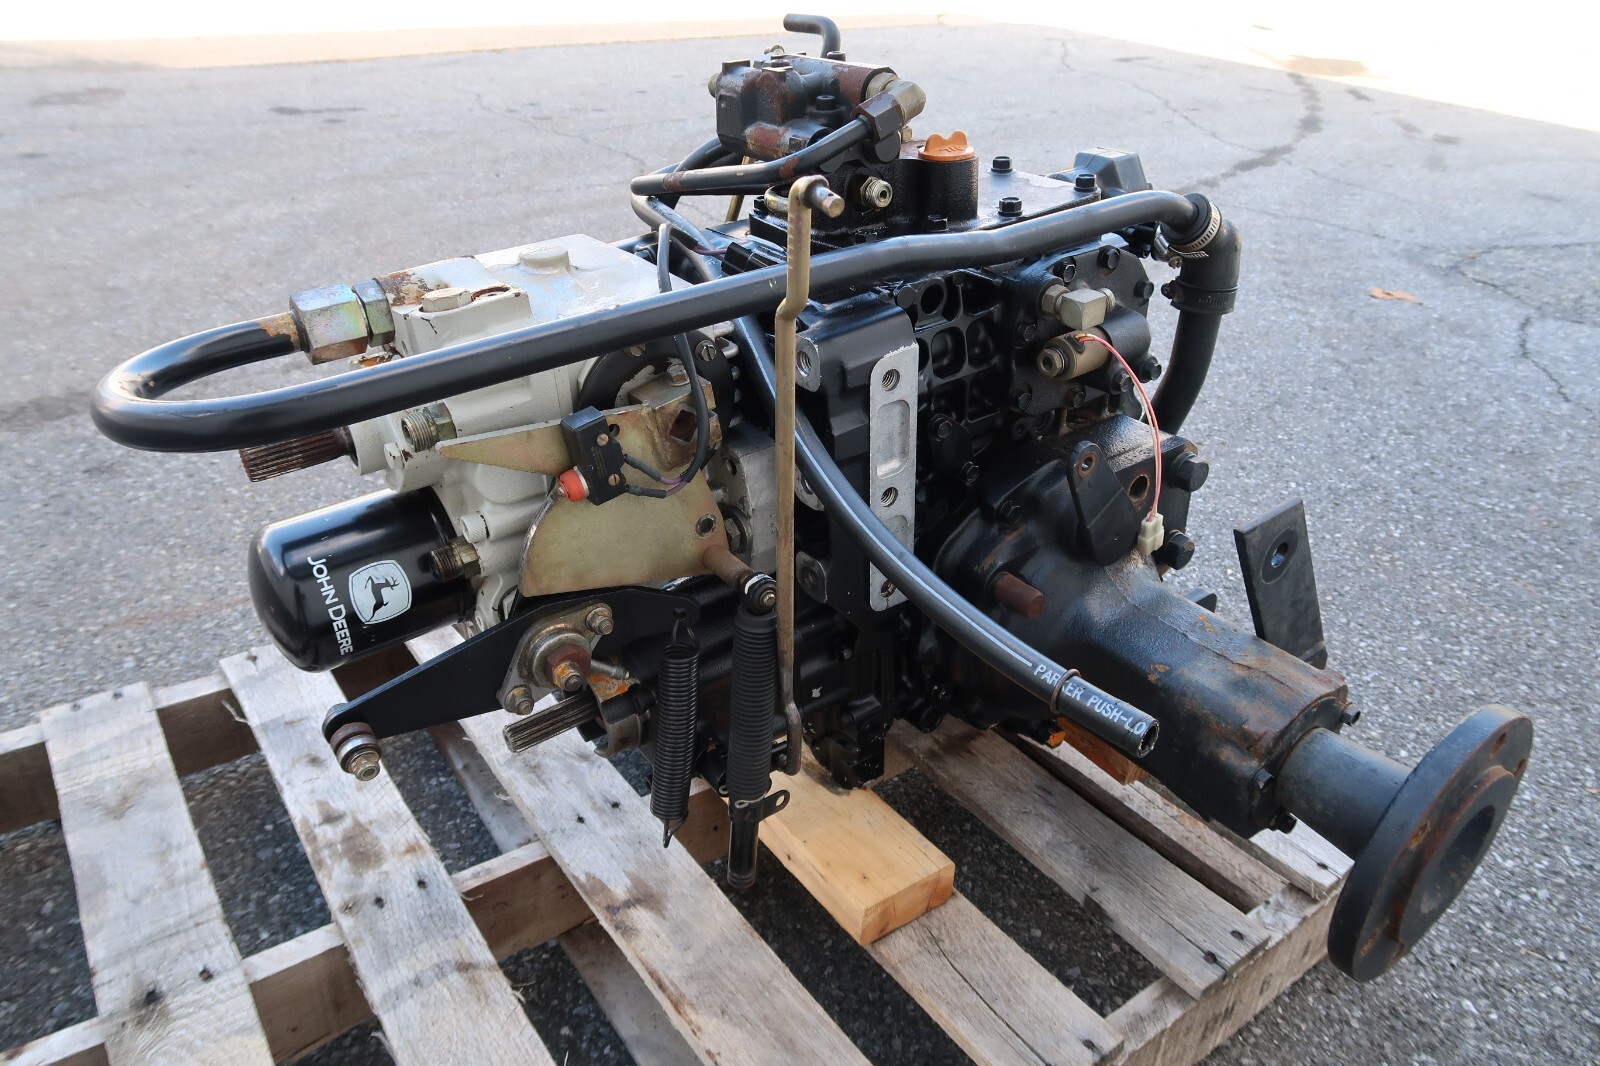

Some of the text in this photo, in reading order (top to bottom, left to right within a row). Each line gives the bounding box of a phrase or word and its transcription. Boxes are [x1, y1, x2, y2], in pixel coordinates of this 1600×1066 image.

[307, 556, 354, 656] JOHN DEERE
[1034, 664, 1084, 701] PARER
